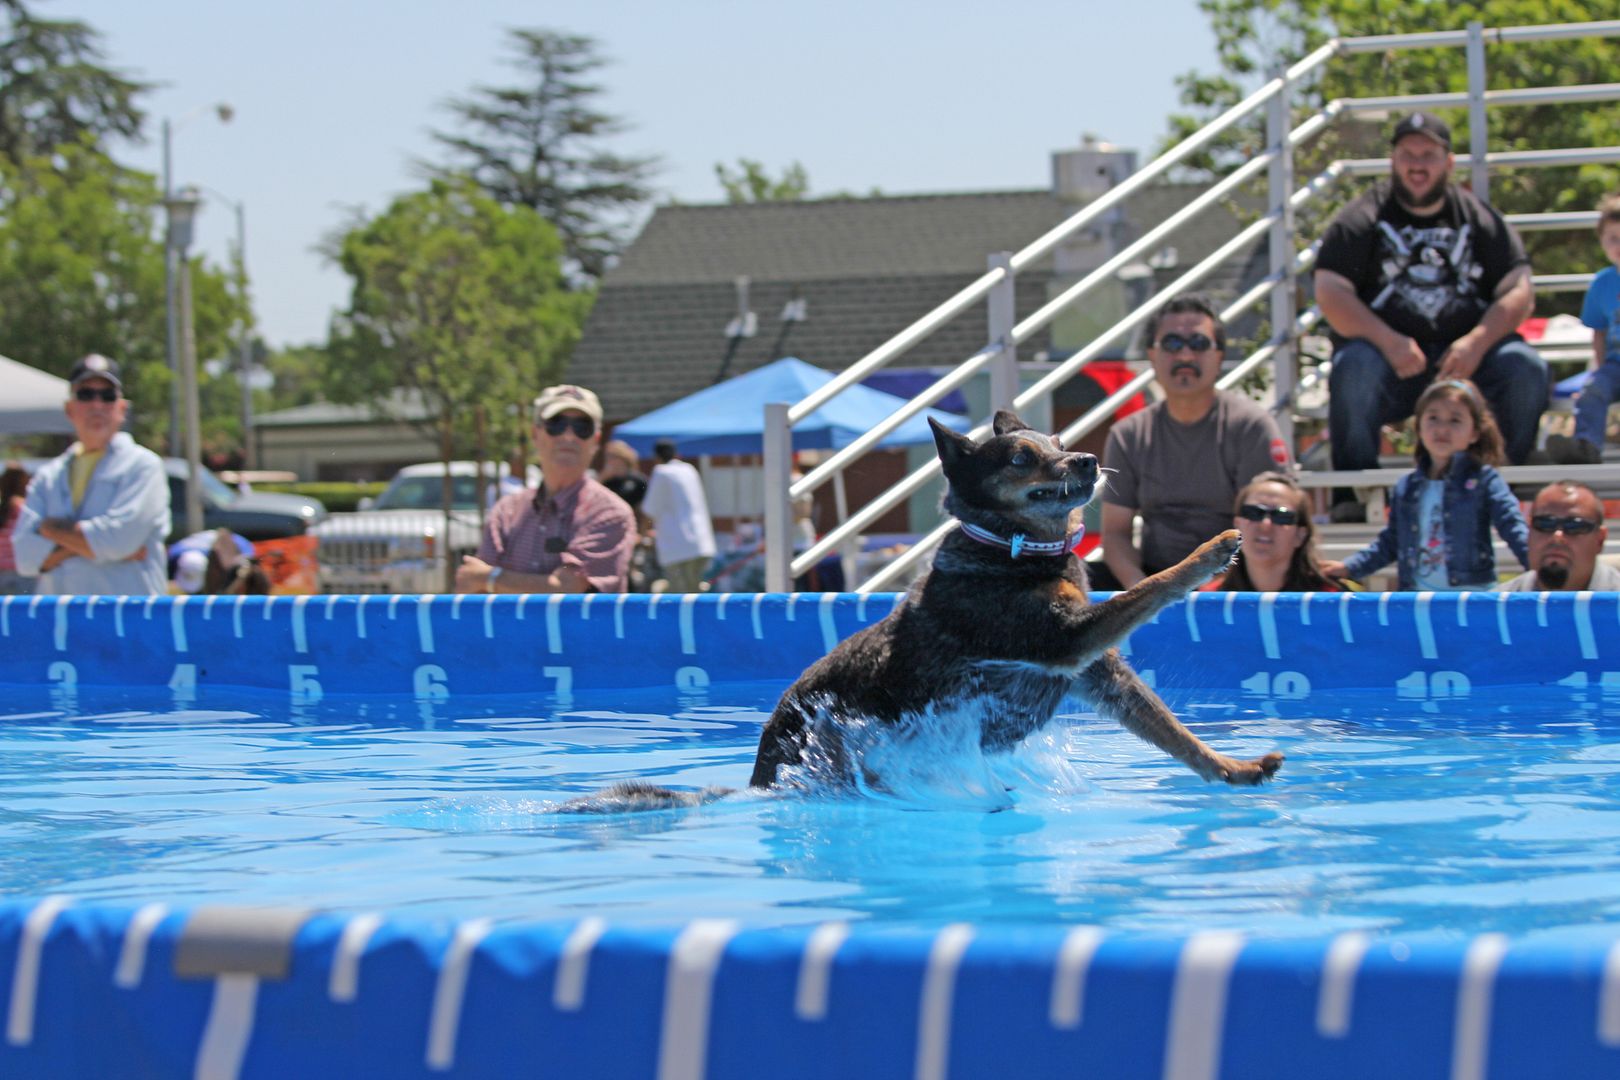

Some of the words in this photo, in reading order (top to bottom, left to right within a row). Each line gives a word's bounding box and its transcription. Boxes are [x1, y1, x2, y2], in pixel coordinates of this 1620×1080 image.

[167, 663, 196, 700] 4
[288, 664, 324, 706] 5
[413, 663, 450, 704] 6
[543, 666, 573, 704] 7
